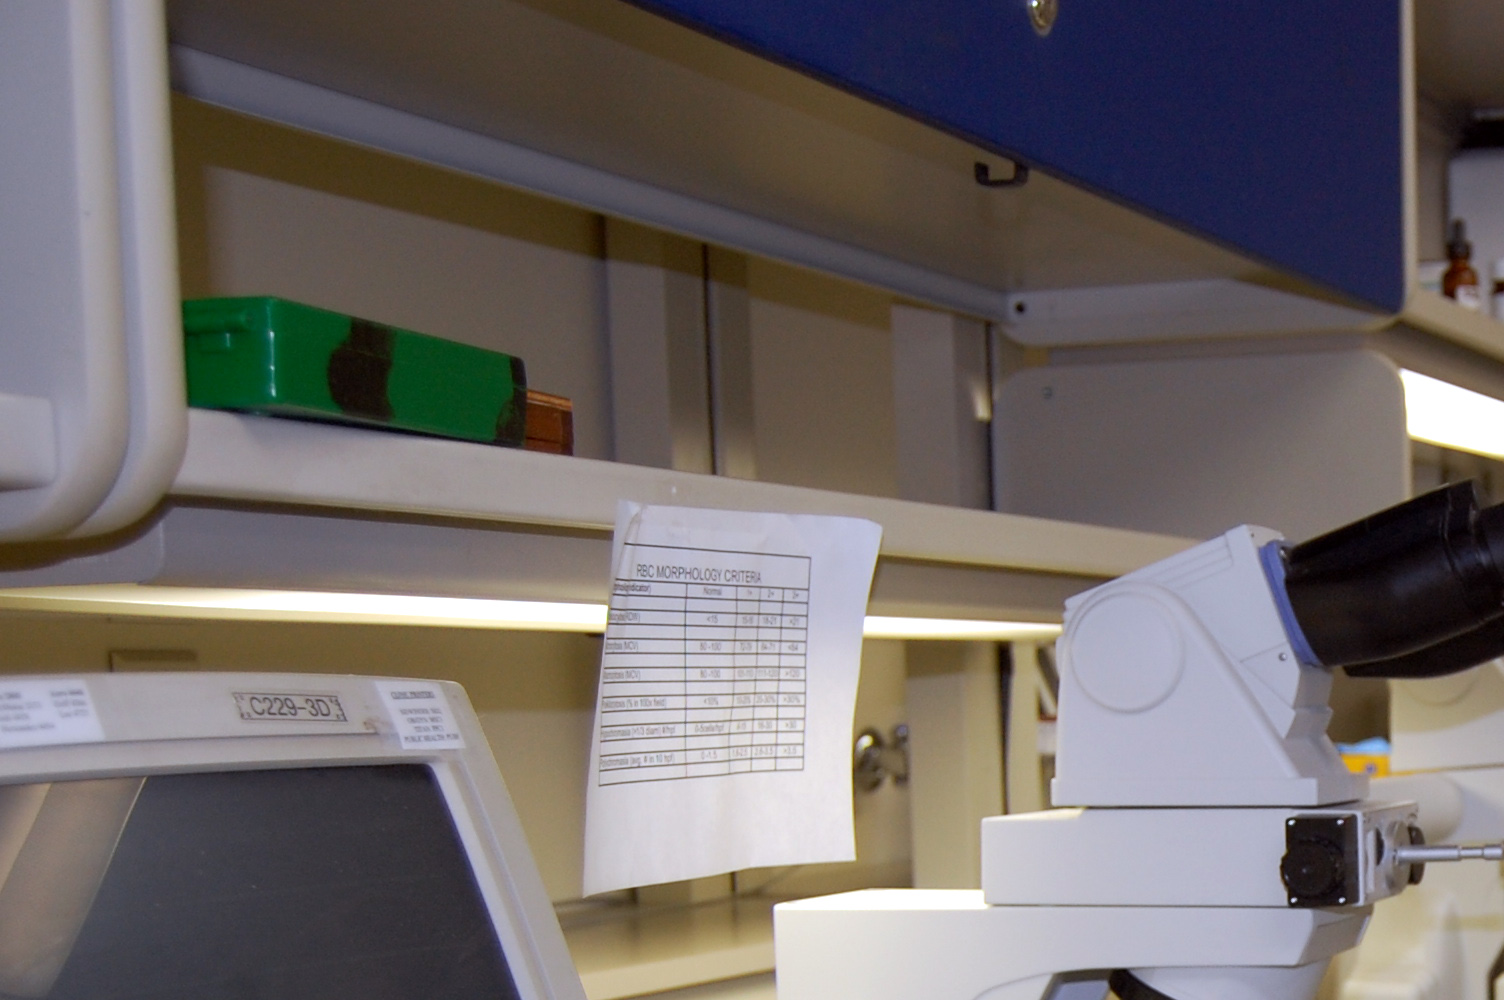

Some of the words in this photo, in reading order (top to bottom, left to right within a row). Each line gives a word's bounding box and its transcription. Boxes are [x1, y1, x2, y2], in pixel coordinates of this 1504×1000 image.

[636, 563, 655, 578] RBC
[656, 565, 722, 582] MORPHOLOGY
[723, 568, 762, 584] CRITERIA
[249, 696, 331, 717] C229-3D
